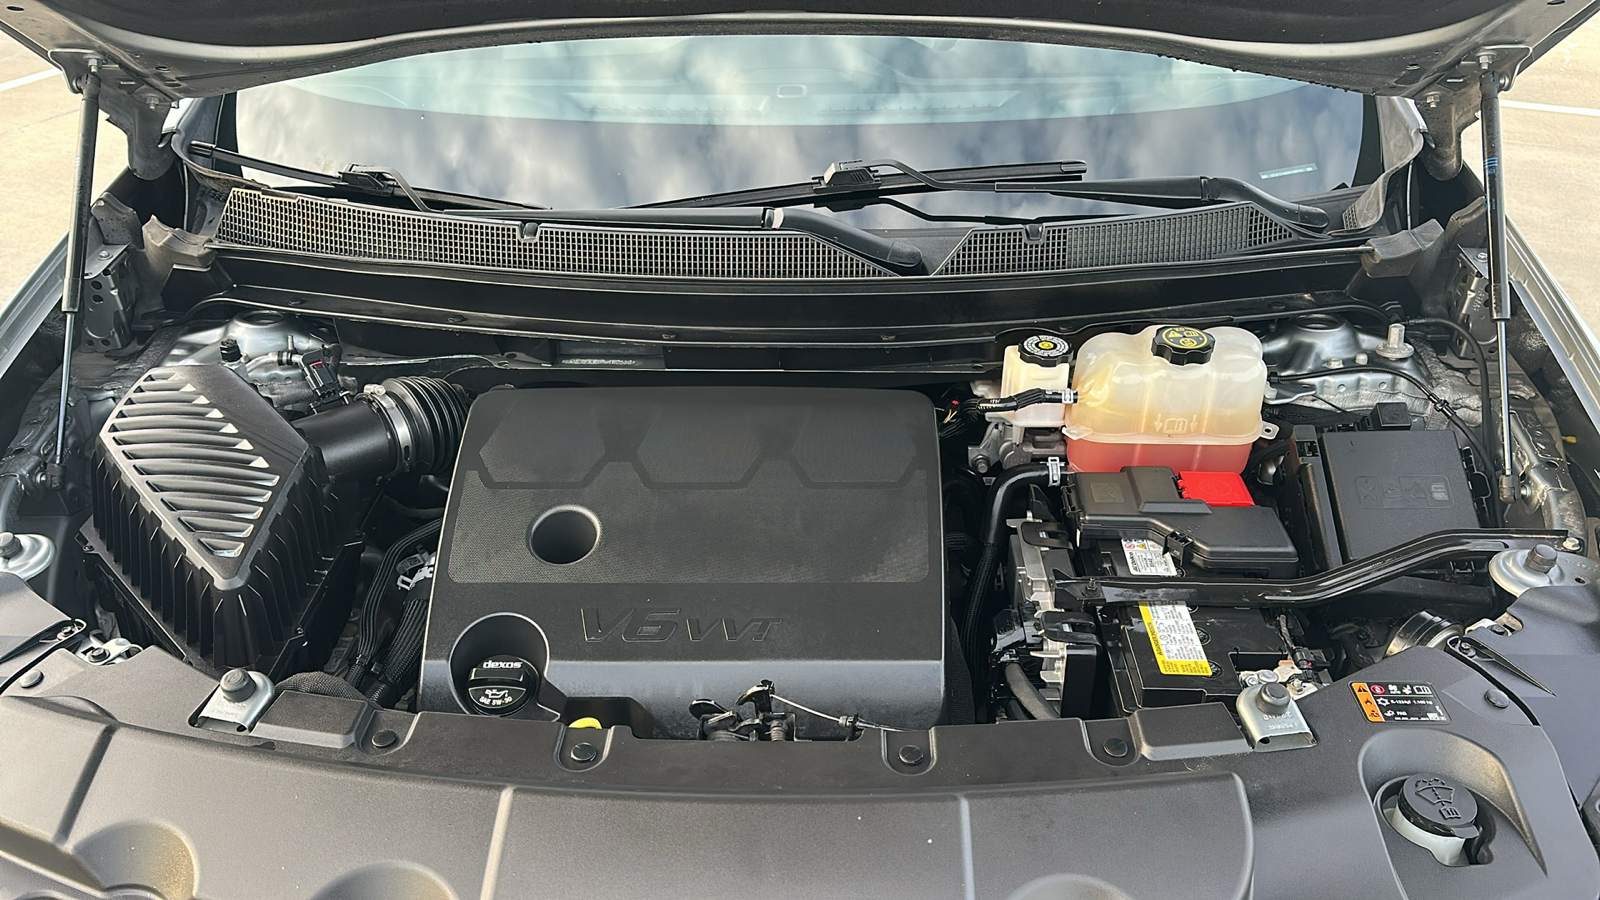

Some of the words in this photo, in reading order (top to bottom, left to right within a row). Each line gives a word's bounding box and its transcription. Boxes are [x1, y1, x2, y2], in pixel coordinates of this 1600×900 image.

[580, 607, 681, 643] V6
[686, 617, 783, 642] VVT
[482, 659, 523, 669] dexos
[479, 696, 492, 705] SAE
[491, 696, 513, 706] 5W-30
